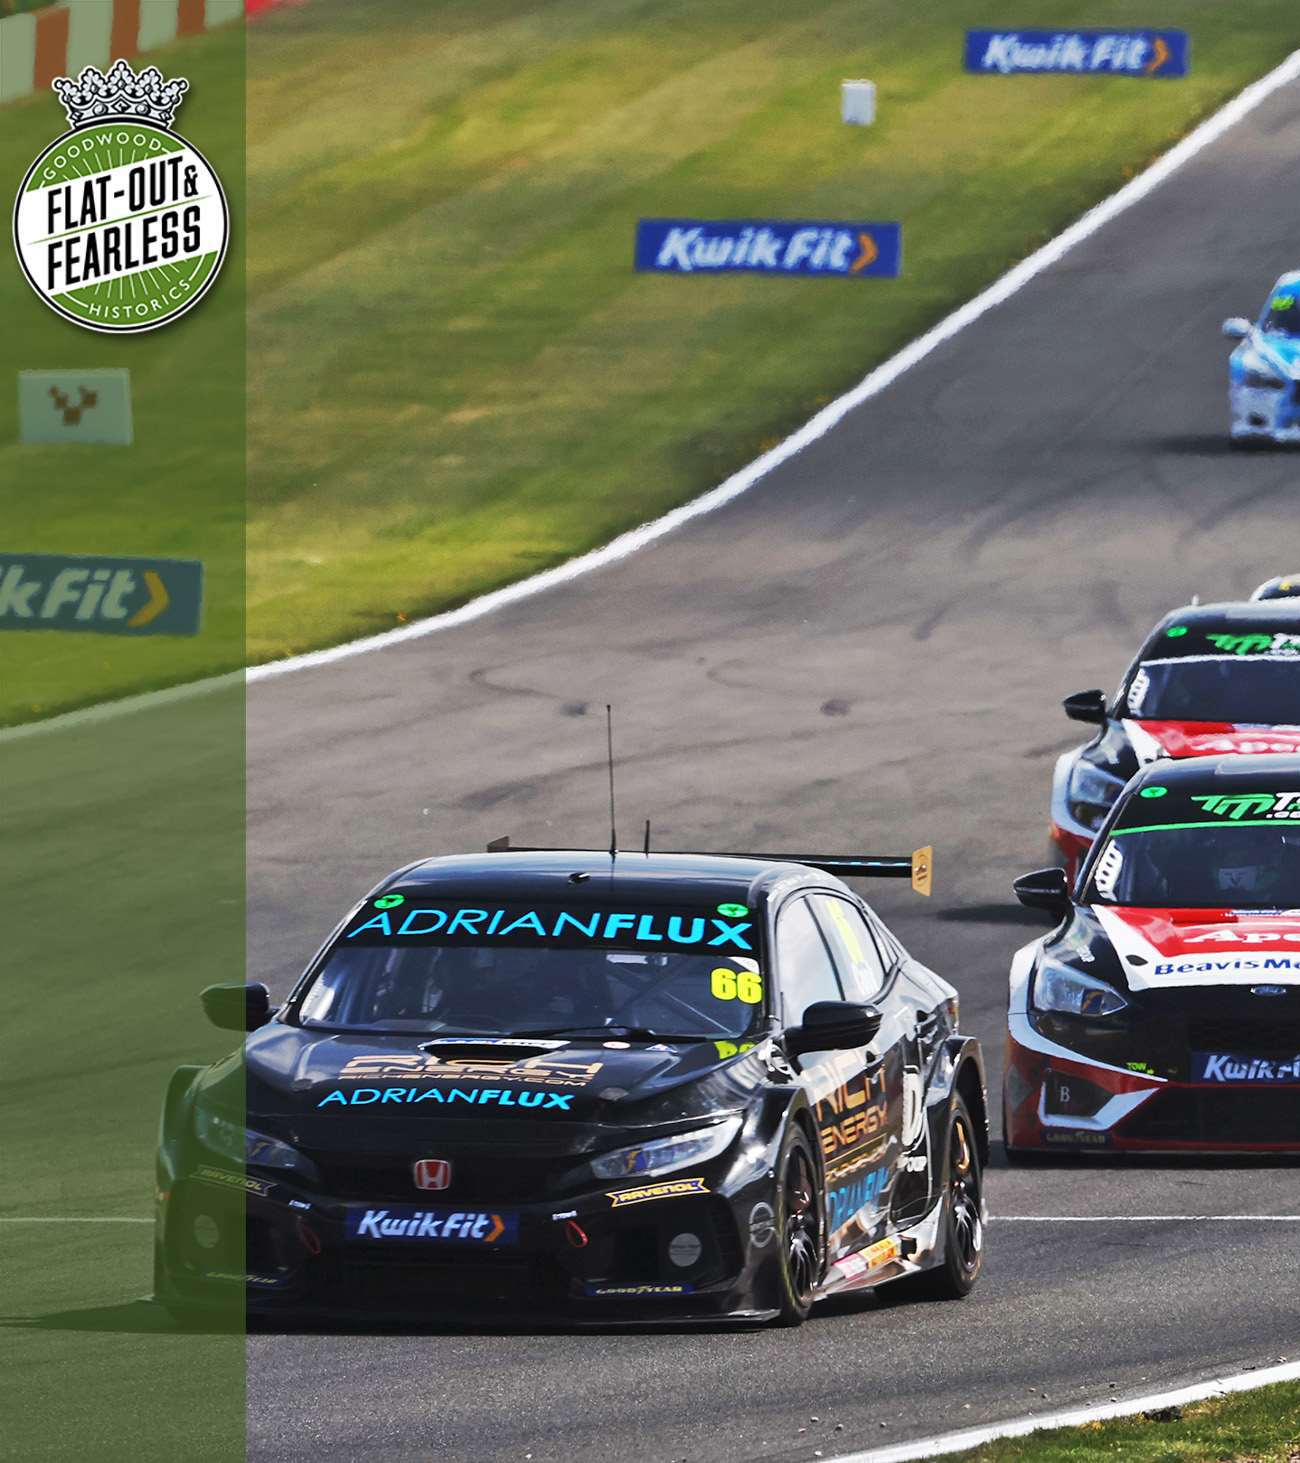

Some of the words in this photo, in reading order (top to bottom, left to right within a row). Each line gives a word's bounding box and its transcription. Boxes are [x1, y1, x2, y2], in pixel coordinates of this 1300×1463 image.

[655, 227, 783, 272] Kwik
[781, 227, 853, 272] Fit
[40, 567, 136, 620] Fit
[710, 967, 763, 1004] 66
[820, 1101, 888, 1155] ENERGY
[619, 1183, 699, 1202] RAVENOL
[357, 1209, 443, 1239] Kwik
[441, 1213, 489, 1239] Fit
[594, 1285, 684, 1296] GOODYEAR
